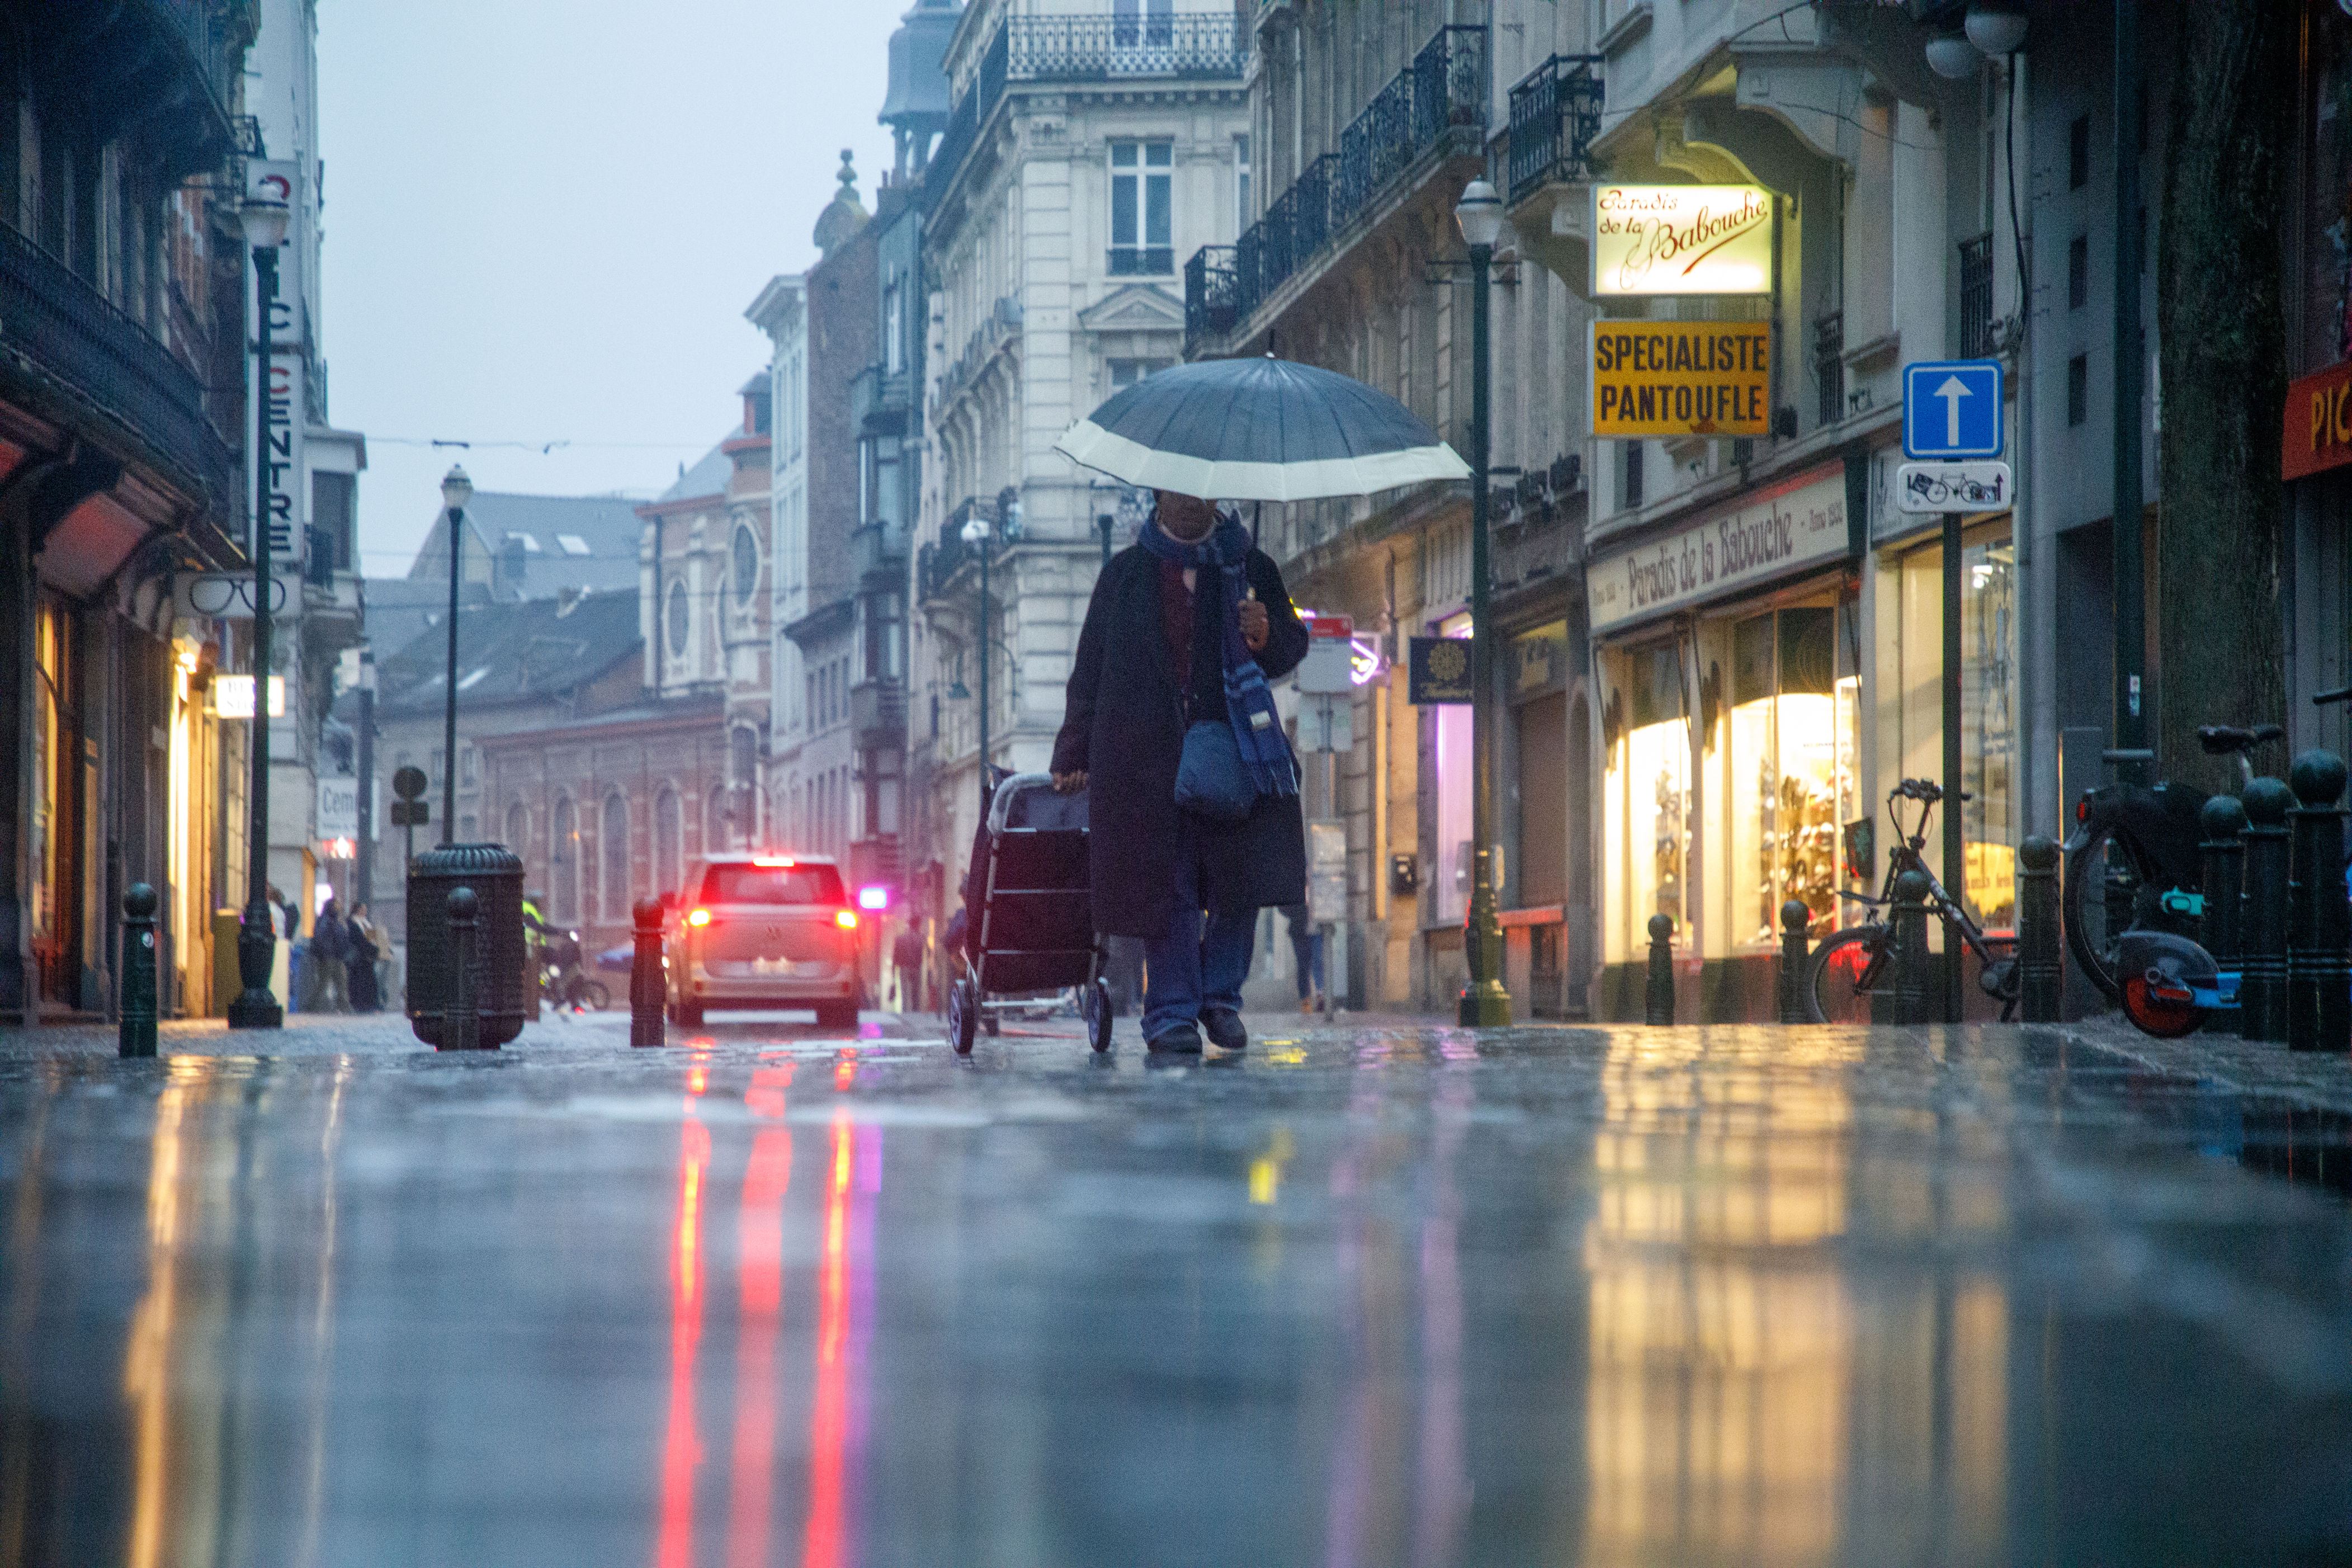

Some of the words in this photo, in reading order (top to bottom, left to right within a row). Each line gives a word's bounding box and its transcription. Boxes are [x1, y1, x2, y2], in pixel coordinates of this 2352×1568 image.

[1599, 189, 1678, 211] Paradis
[1599, 217, 1621, 234] de
[1626, 216, 1642, 234] la
[1659, 190, 1768, 259] Babouche
[1597, 334, 1767, 372] SPECIALISTE
[1600, 384, 1763, 422] PANTOUFLE
[1628, 545, 1676, 609] Paradis
[1680, 537, 1697, 590] de
[1702, 530, 1714, 584] la
[1720, 503, 1793, 578] Babouche
